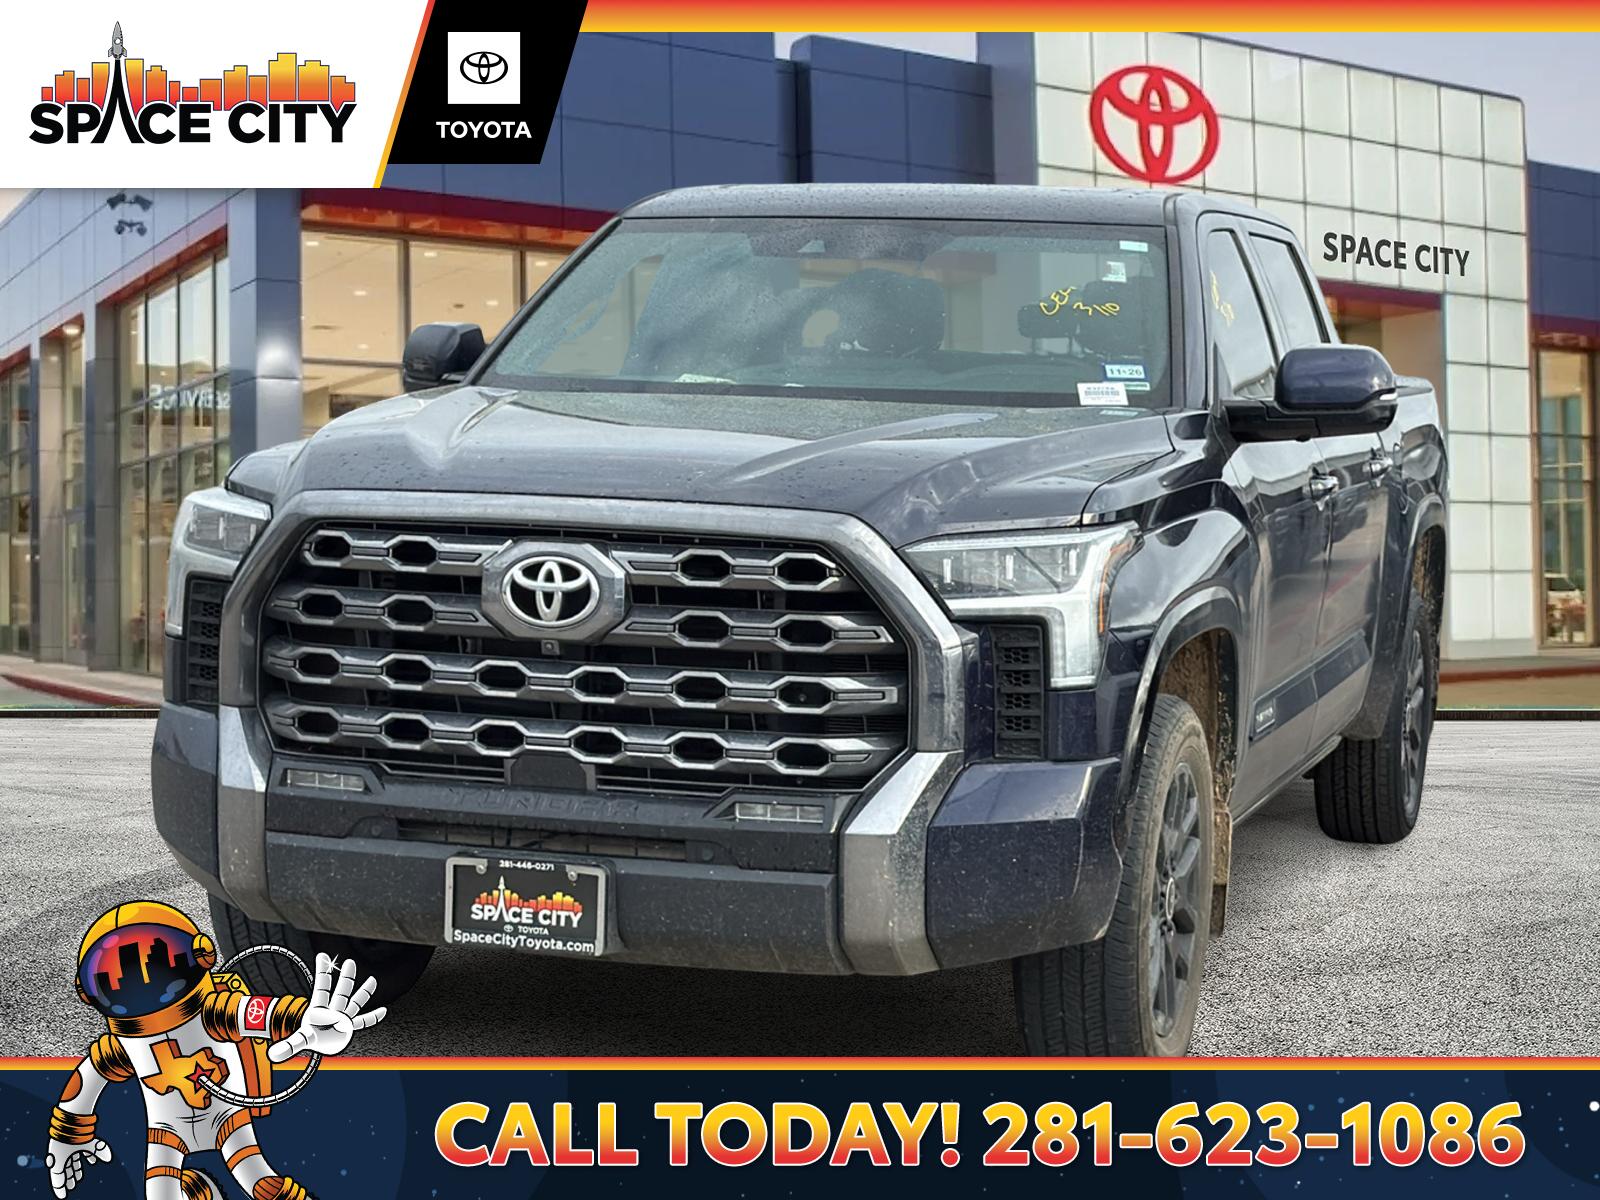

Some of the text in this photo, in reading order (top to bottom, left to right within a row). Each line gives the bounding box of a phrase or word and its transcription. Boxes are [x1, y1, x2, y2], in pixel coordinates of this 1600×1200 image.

[1323, 232, 1470, 277] SPACE CITY
[538, 908, 583, 928] CITY
[453, 929, 595, 953] SpaceCityToyota.com
[518, 925, 549, 936] TOYOTA
